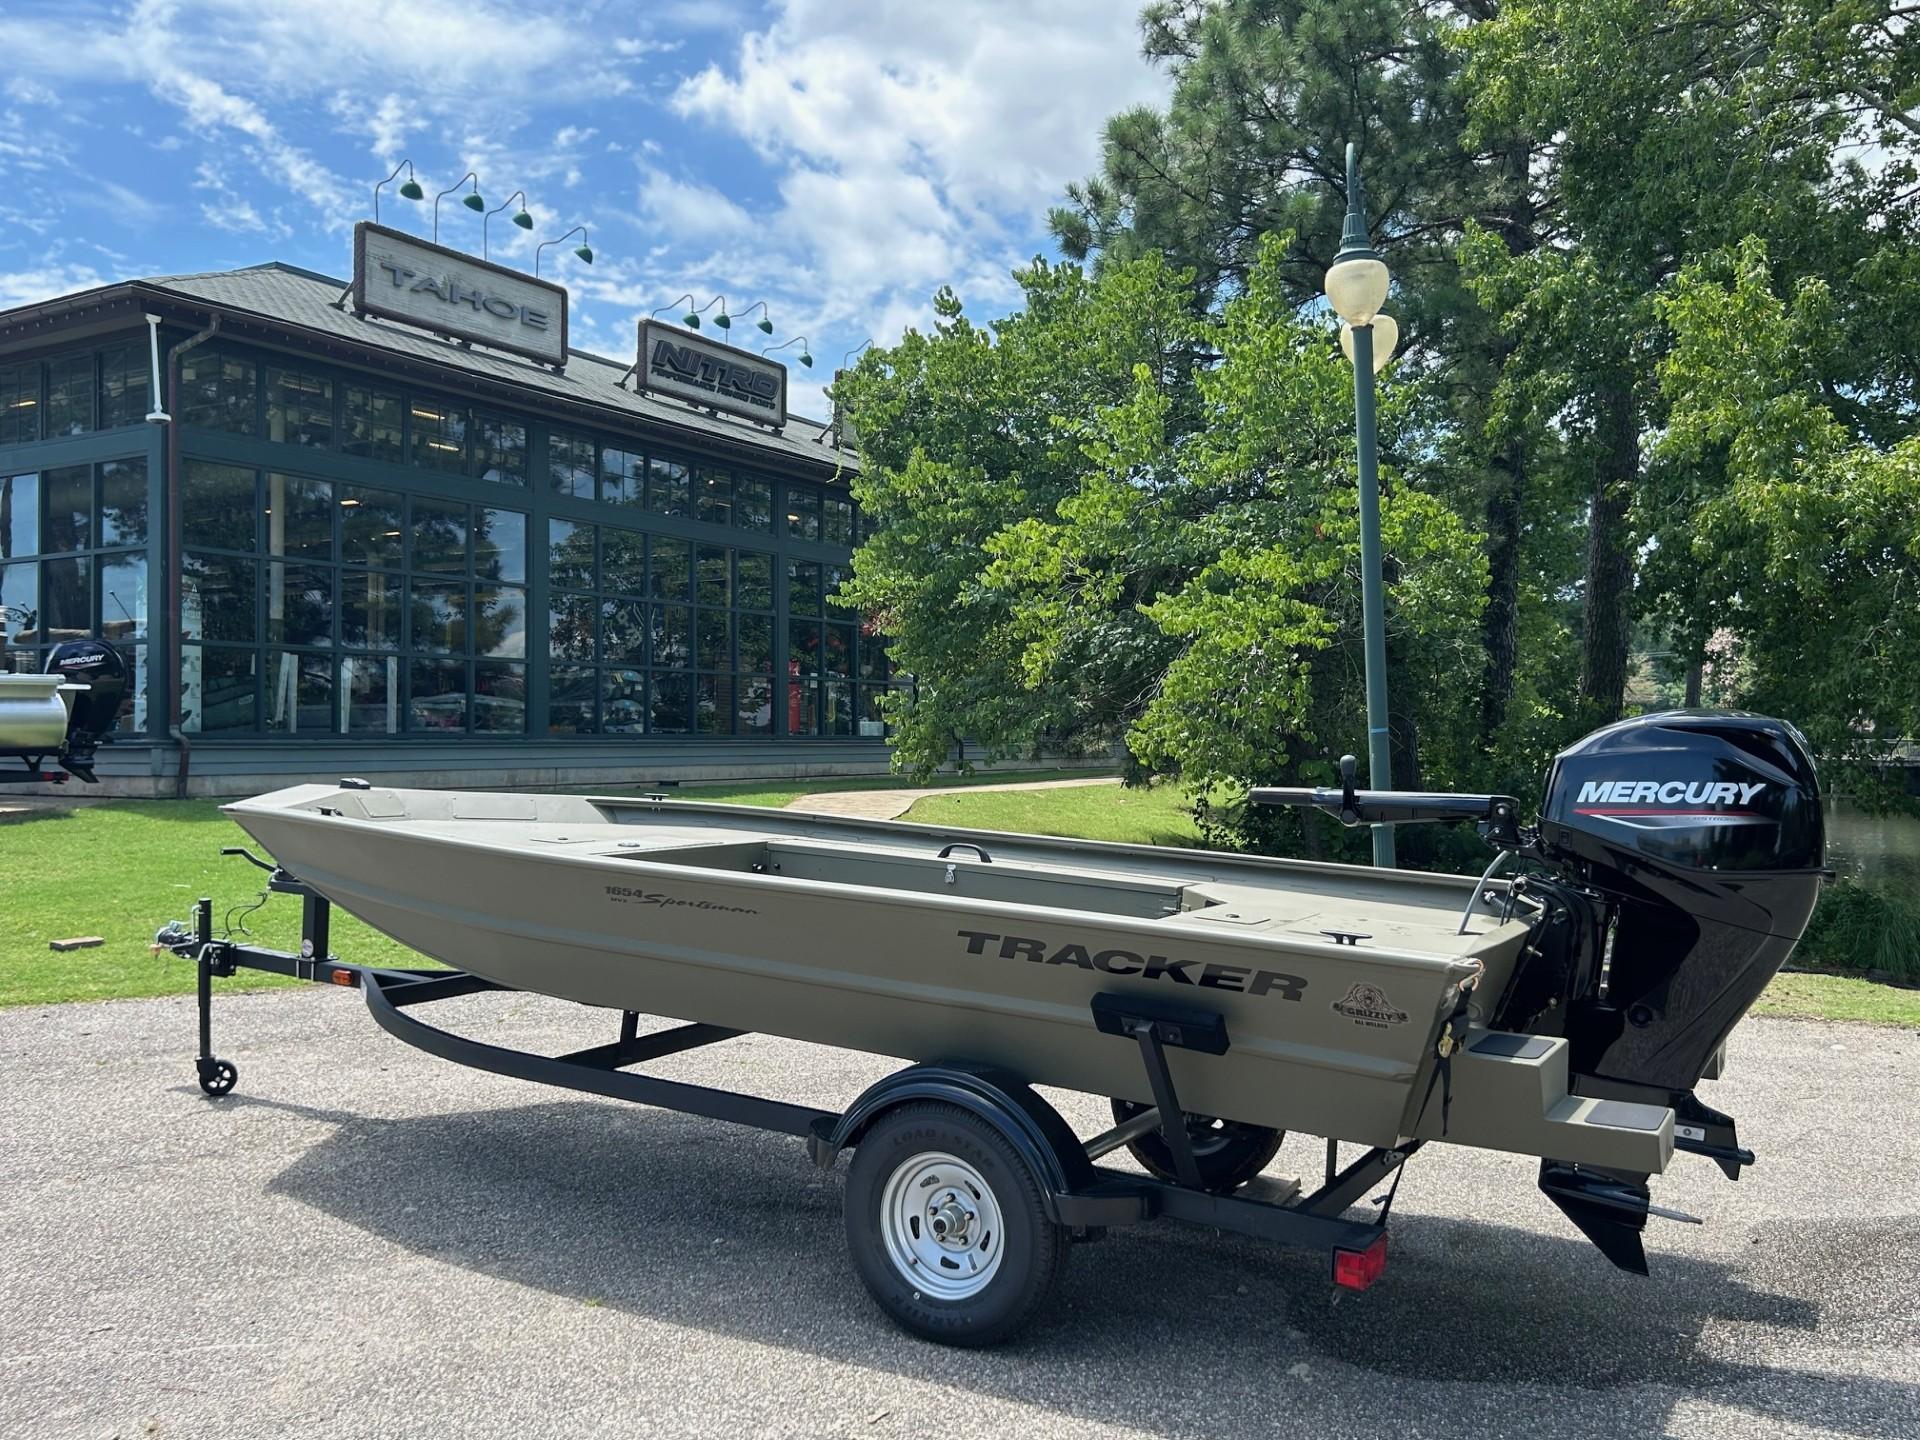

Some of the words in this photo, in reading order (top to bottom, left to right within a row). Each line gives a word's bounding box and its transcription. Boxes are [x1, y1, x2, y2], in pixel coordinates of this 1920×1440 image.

[381, 262, 549, 333] TAHOE
[651, 340, 780, 401] NITRO
[59, 654, 105, 666] MERCURY
[1576, 781, 1766, 805] MERCURY
[604, 886, 643, 898] 1654
[634, 893, 759, 915] Sportsman
[957, 930, 1309, 1002] TRACKER
[1347, 1007, 1393, 1021] GRIZZLY
